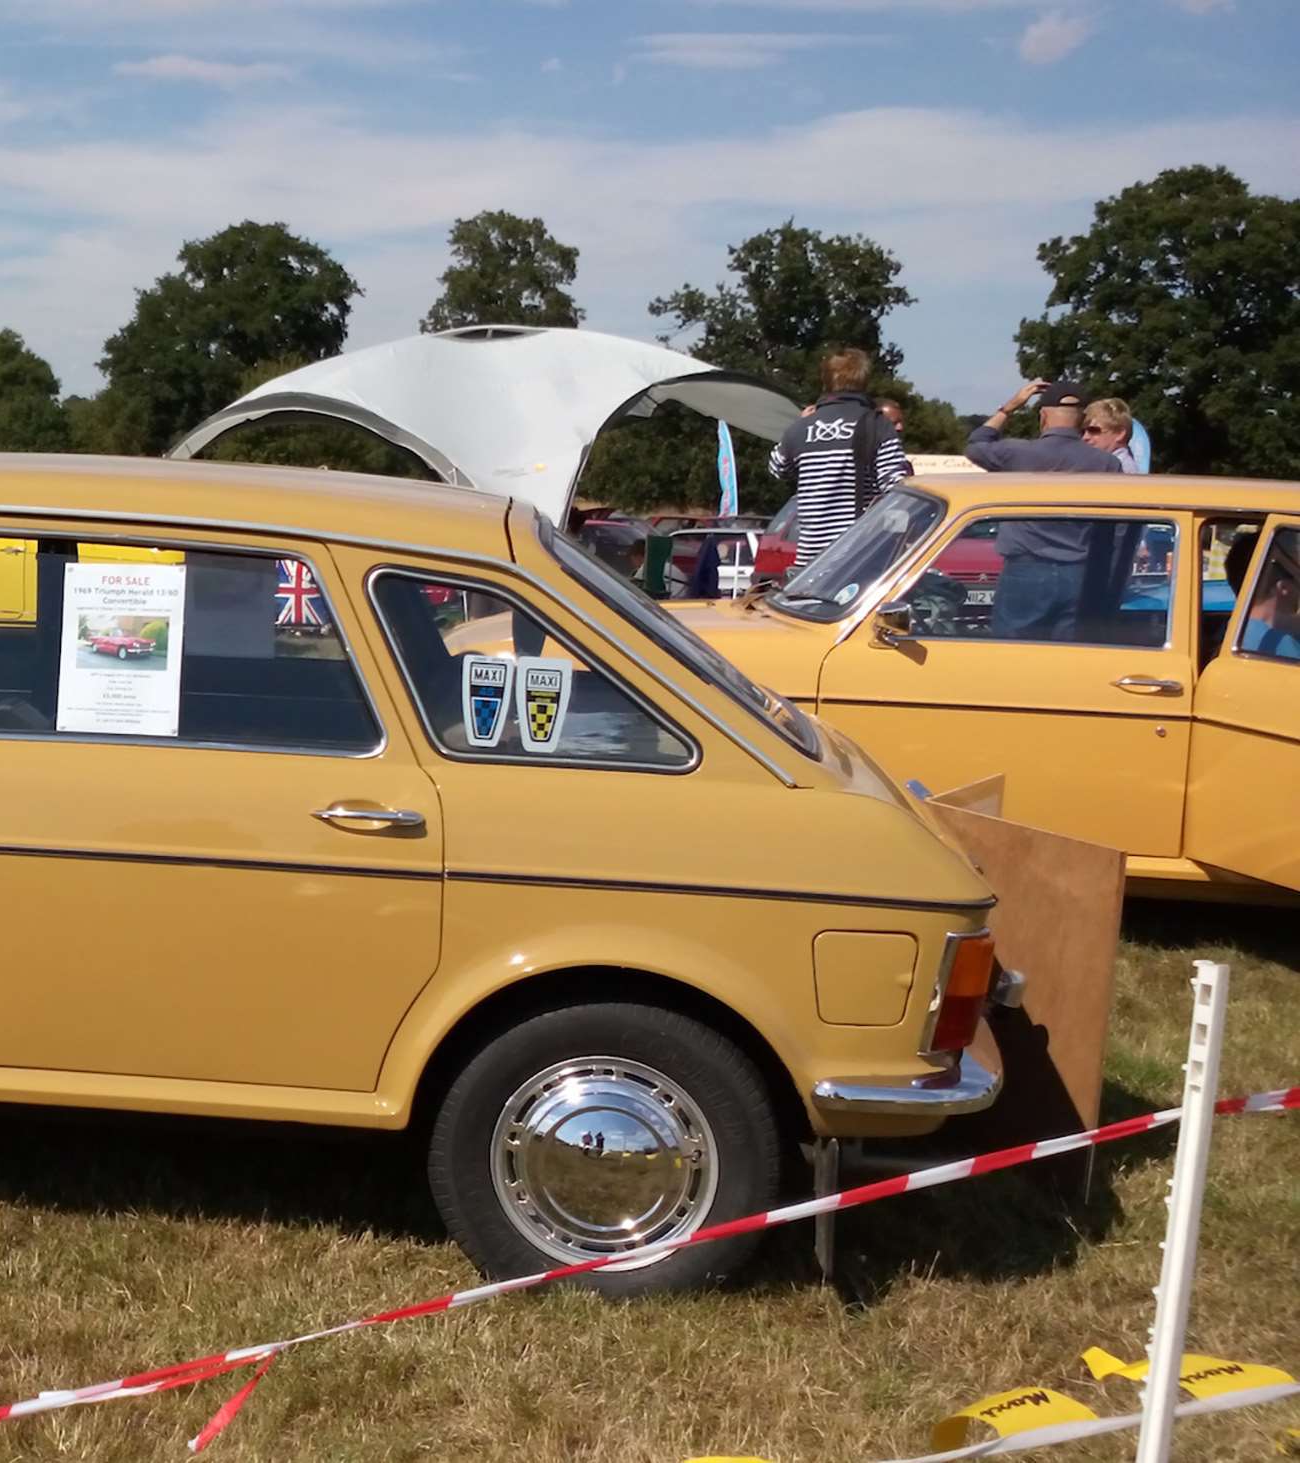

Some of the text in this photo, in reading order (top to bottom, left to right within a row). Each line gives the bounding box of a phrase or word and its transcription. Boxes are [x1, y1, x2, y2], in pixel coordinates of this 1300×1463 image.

[102, 576, 151, 586] FOR SALE
[95, 588, 126, 596] Triumph
[102, 597, 146, 605] Convertible
[474, 668, 503, 682] MAXI
[980, 1390, 1051, 1418] Maxi
